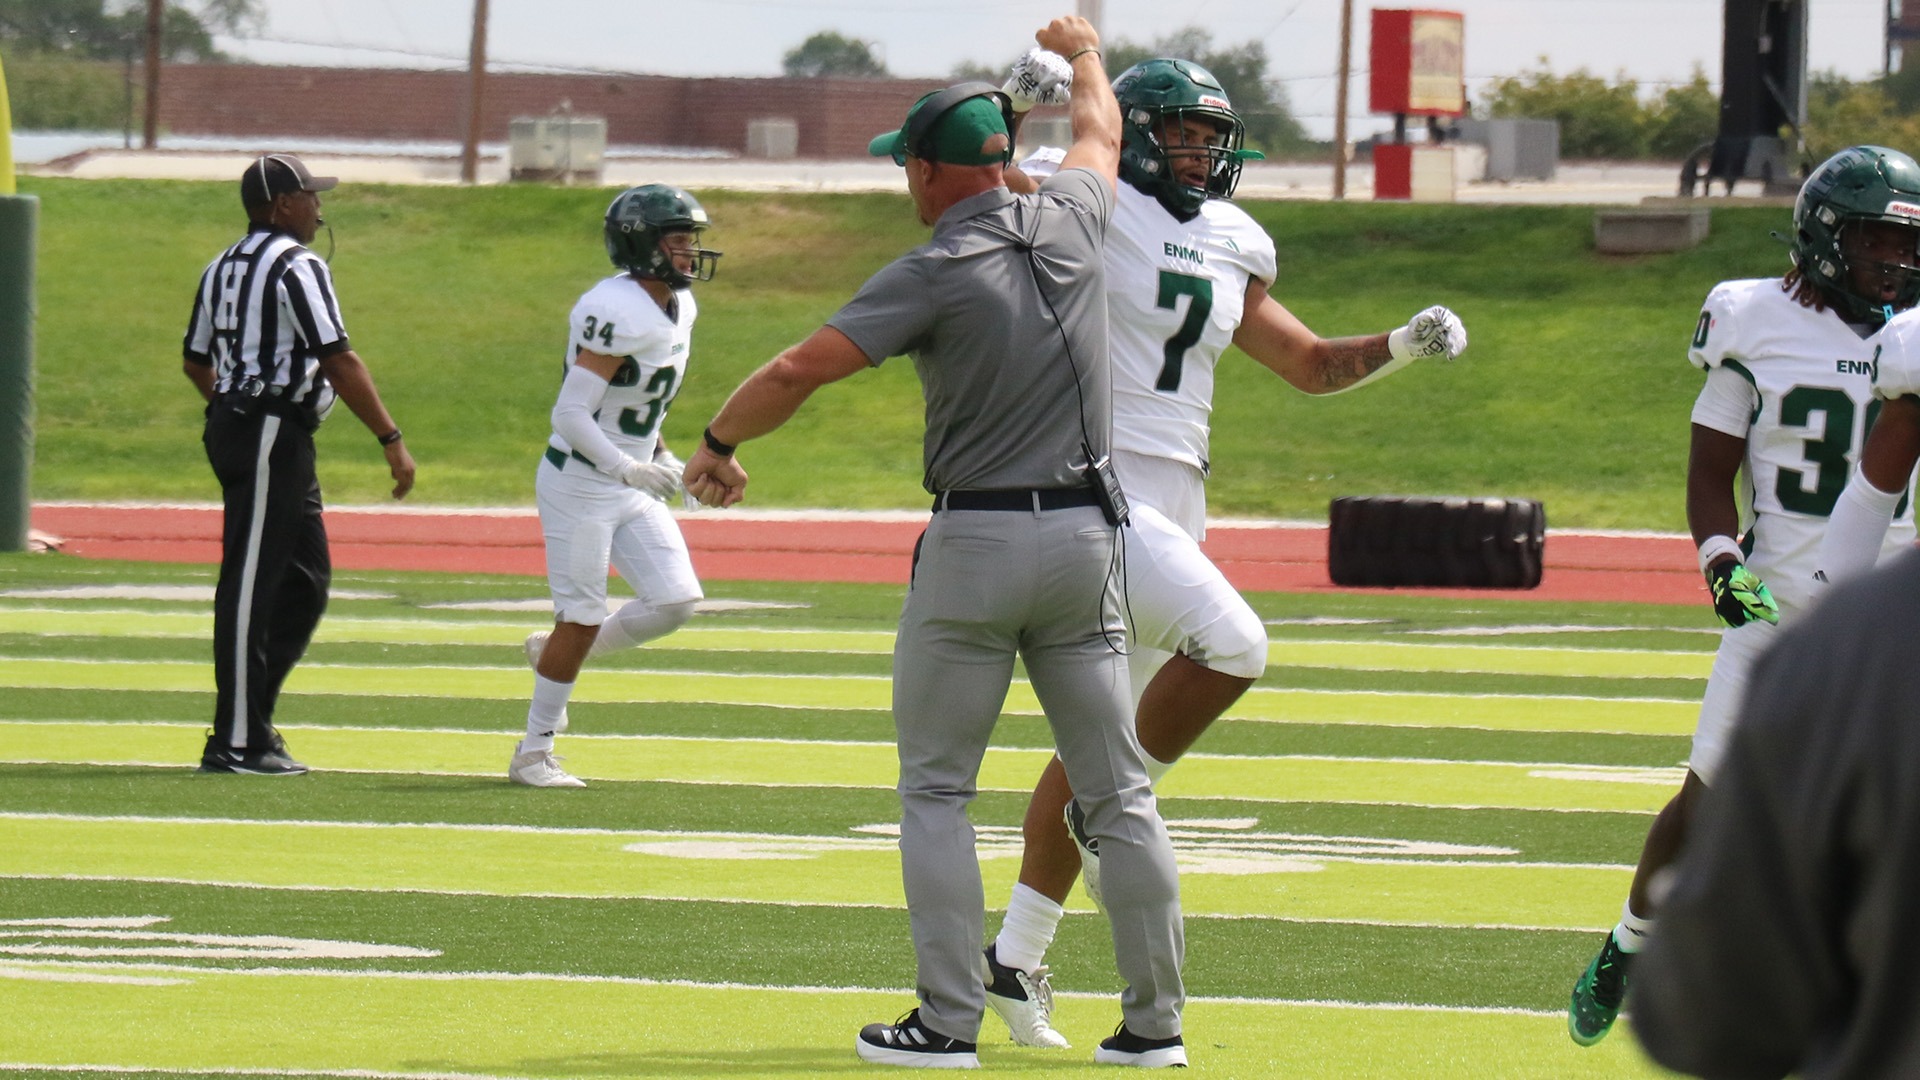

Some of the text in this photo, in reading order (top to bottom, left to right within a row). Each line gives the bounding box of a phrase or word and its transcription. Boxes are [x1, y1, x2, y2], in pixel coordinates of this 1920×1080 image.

[1163, 241, 1205, 265] ENMU
[582, 314, 616, 348] 34
[1154, 269, 1213, 393] 7
[617, 364, 678, 438] 3
